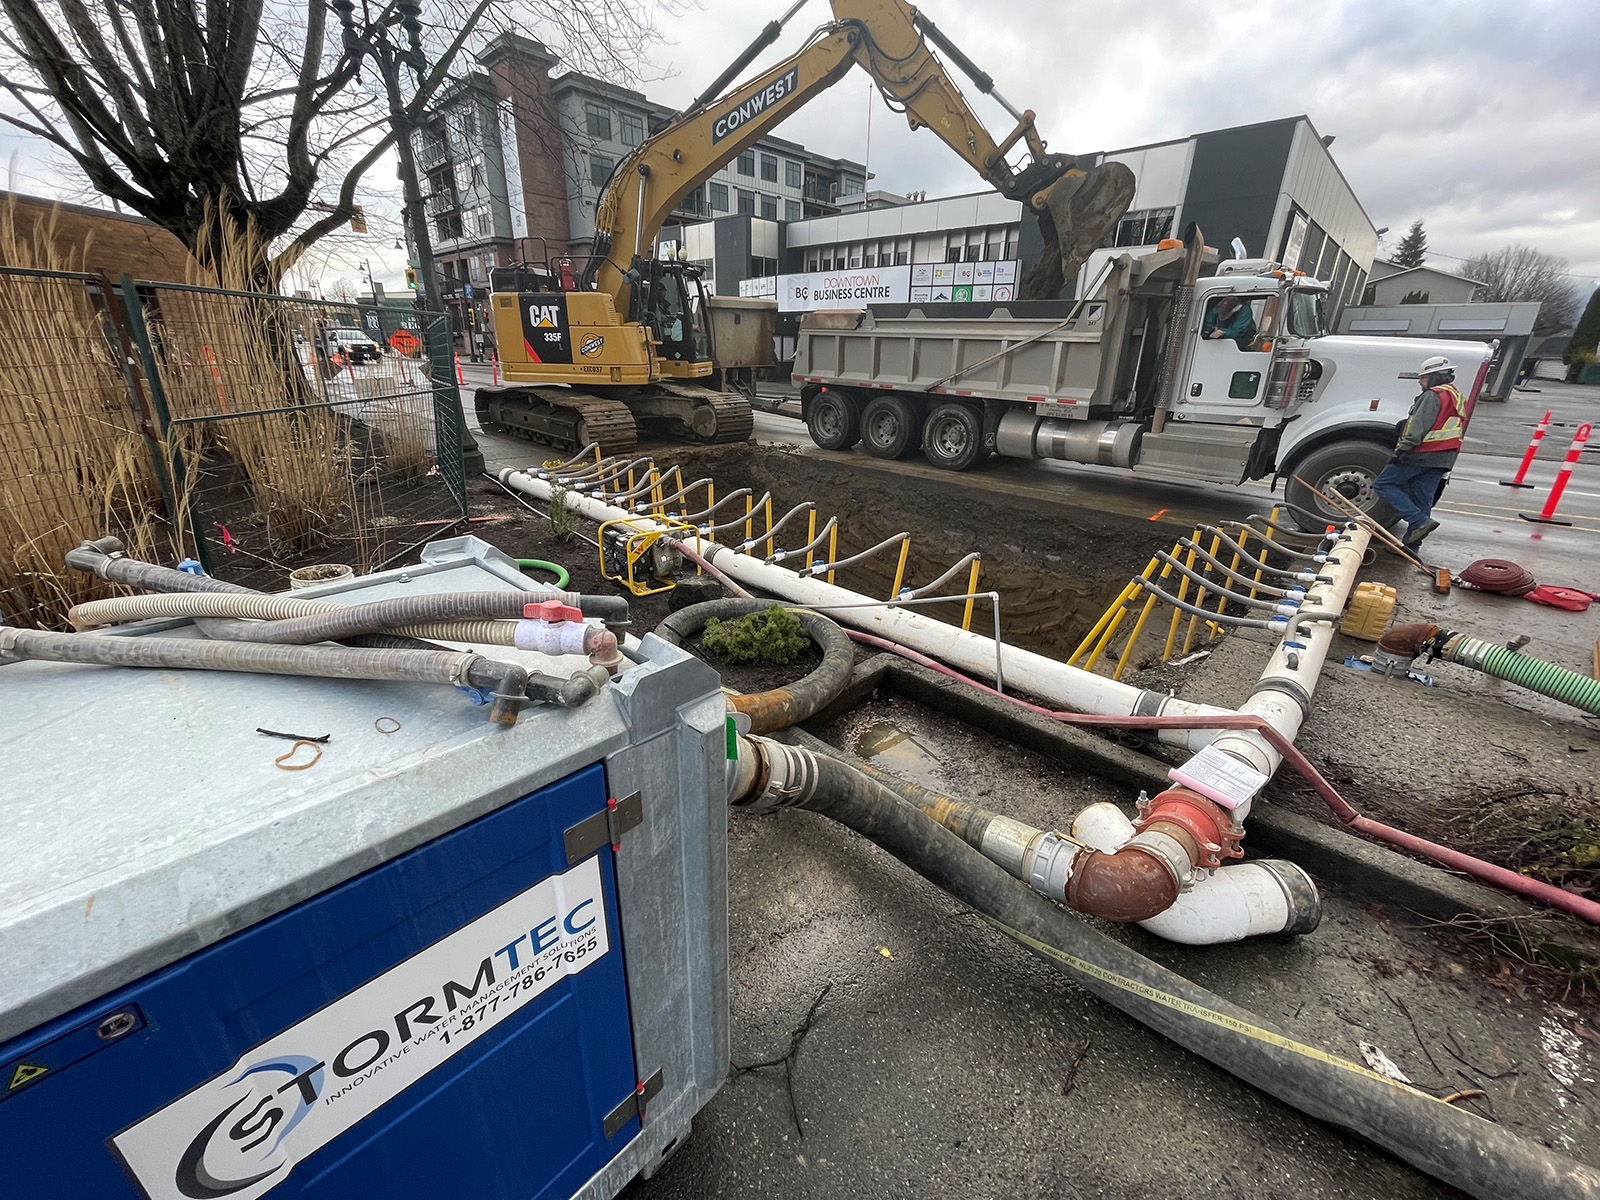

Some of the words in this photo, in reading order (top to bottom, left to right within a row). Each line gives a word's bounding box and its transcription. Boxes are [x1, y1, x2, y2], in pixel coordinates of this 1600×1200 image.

[715, 70, 795, 137] CONWEST
[813, 287, 852, 301] BUSINESS
[854, 286, 891, 299] CENTRE
[824, 275, 880, 289] DOWNTOWN
[529, 304, 559, 328] CAT
[543, 332, 562, 342] 335F
[581, 337, 604, 353] CONWEST
[439, 936, 598, 1045] 1-877-786-7655
[1102, 972, 1154, 997] CONTRACTORS
[1155, 992, 1182, 1008] WATER
[1183, 1002, 1223, 1022] TRANSFER
[1225, 1018, 1238, 1028] 150
[1239, 1023, 1252, 1033] PSI
[229, 898, 596, 1153] STORMTEC
[325, 1045, 410, 1105] INNOVATIVE
[413, 1015, 457, 1046] WATER
[459, 957, 540, 1015] MANAGEMENT
[542, 927, 597, 961] SOLUTIONS
